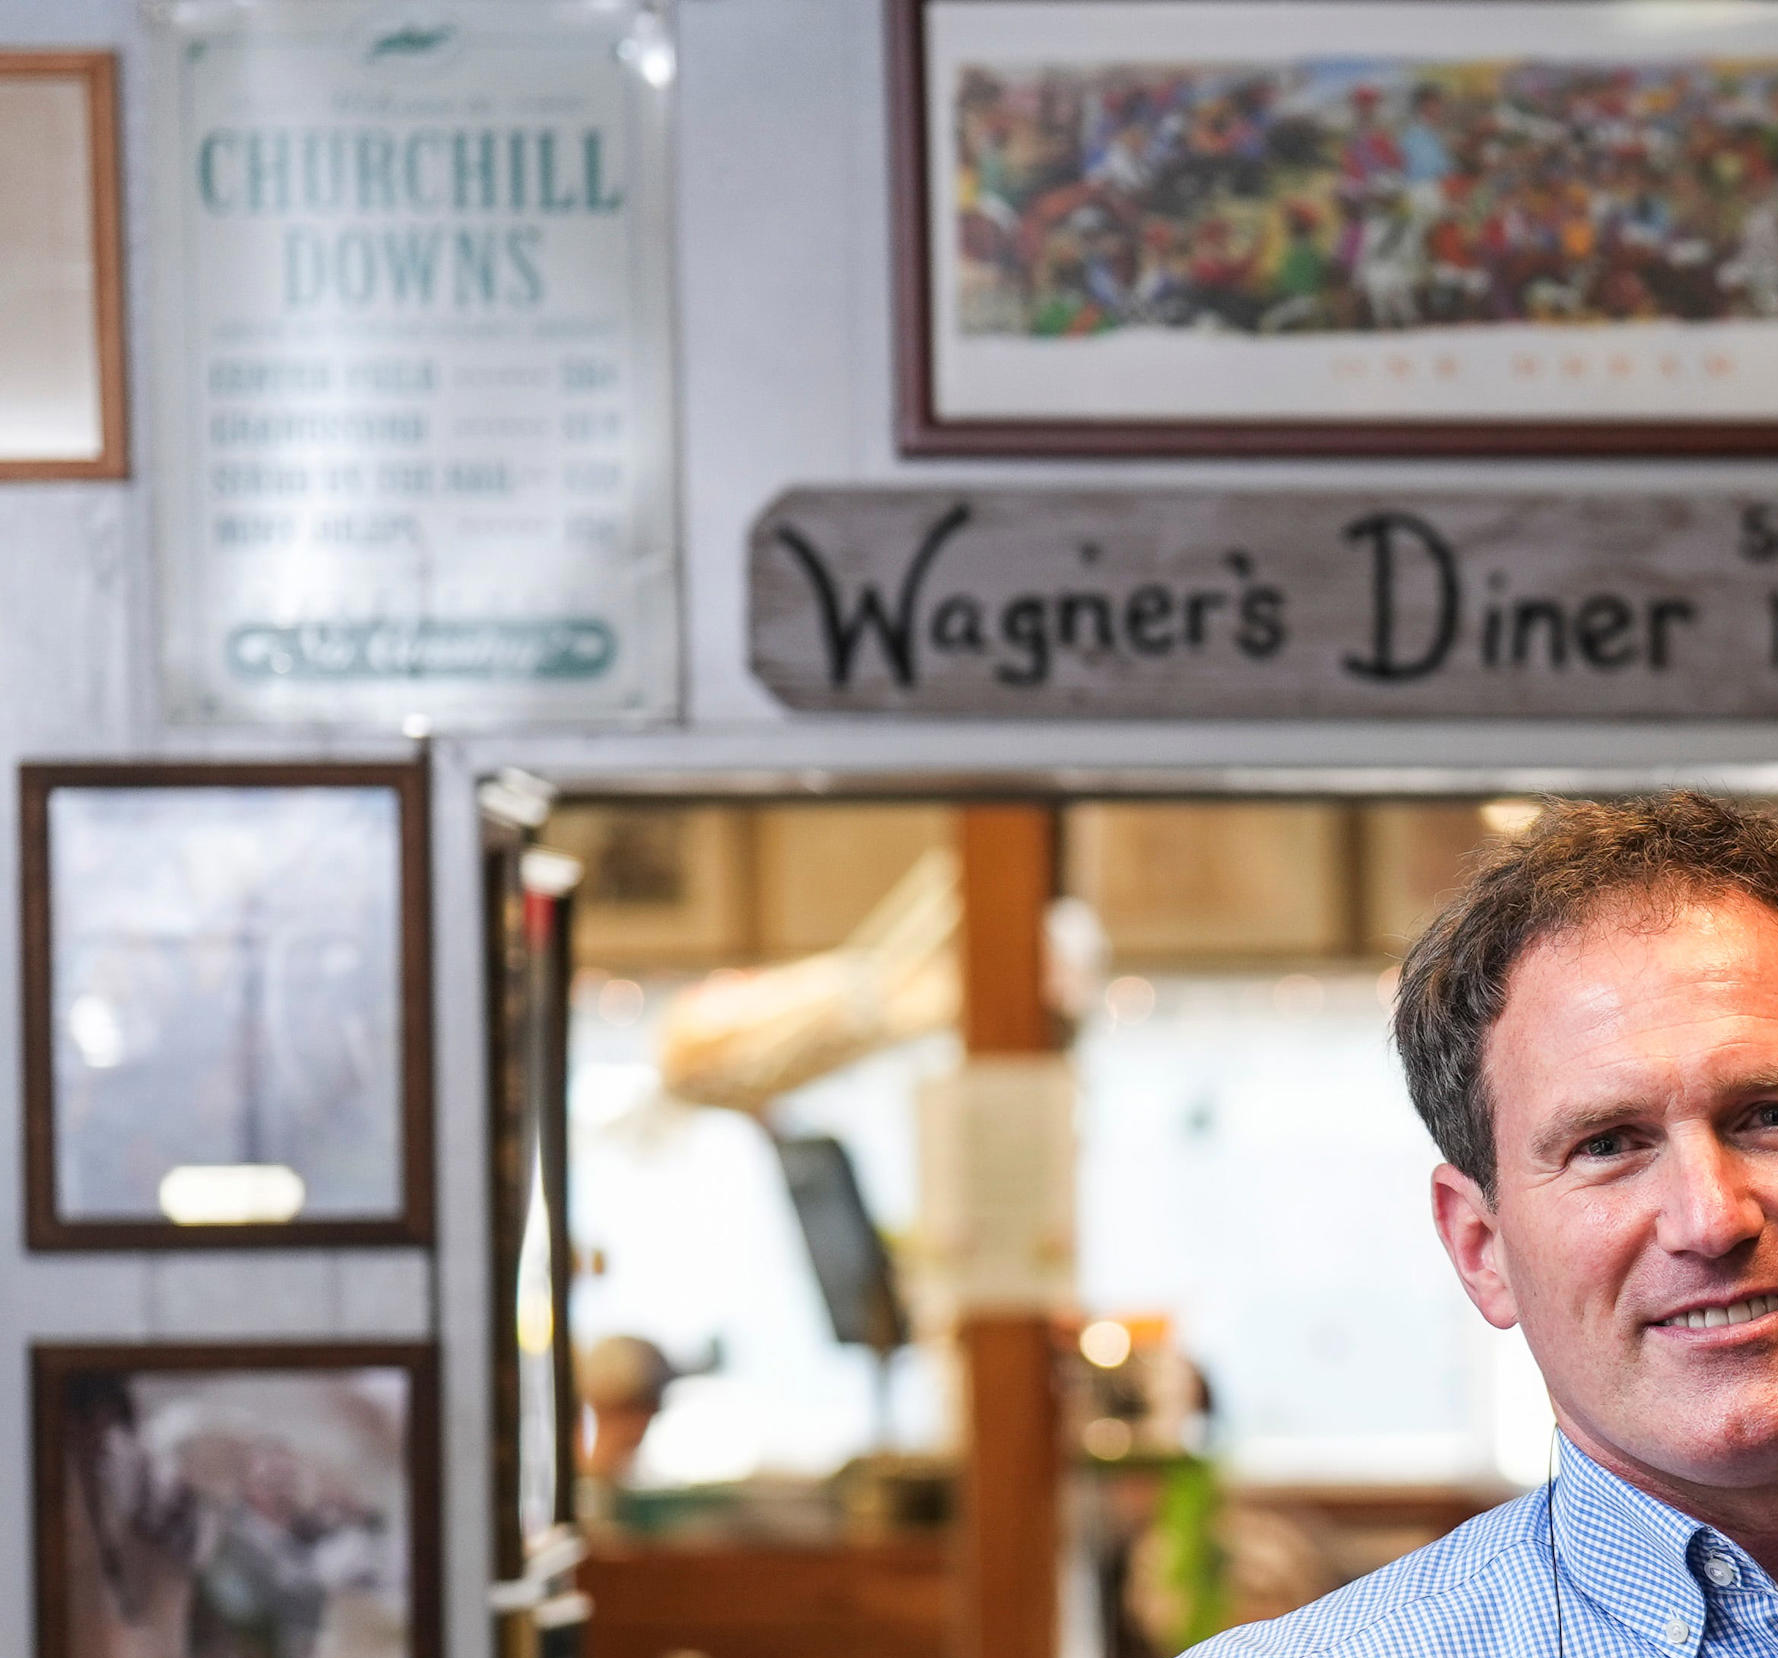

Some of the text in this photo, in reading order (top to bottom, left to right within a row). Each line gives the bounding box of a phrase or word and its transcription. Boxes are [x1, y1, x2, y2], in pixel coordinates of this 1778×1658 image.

[199, 128, 625, 216] CHURCHILL
[282, 222, 548, 312] DOWNS
[776, 501, 1696, 692] Wagner's Diner
